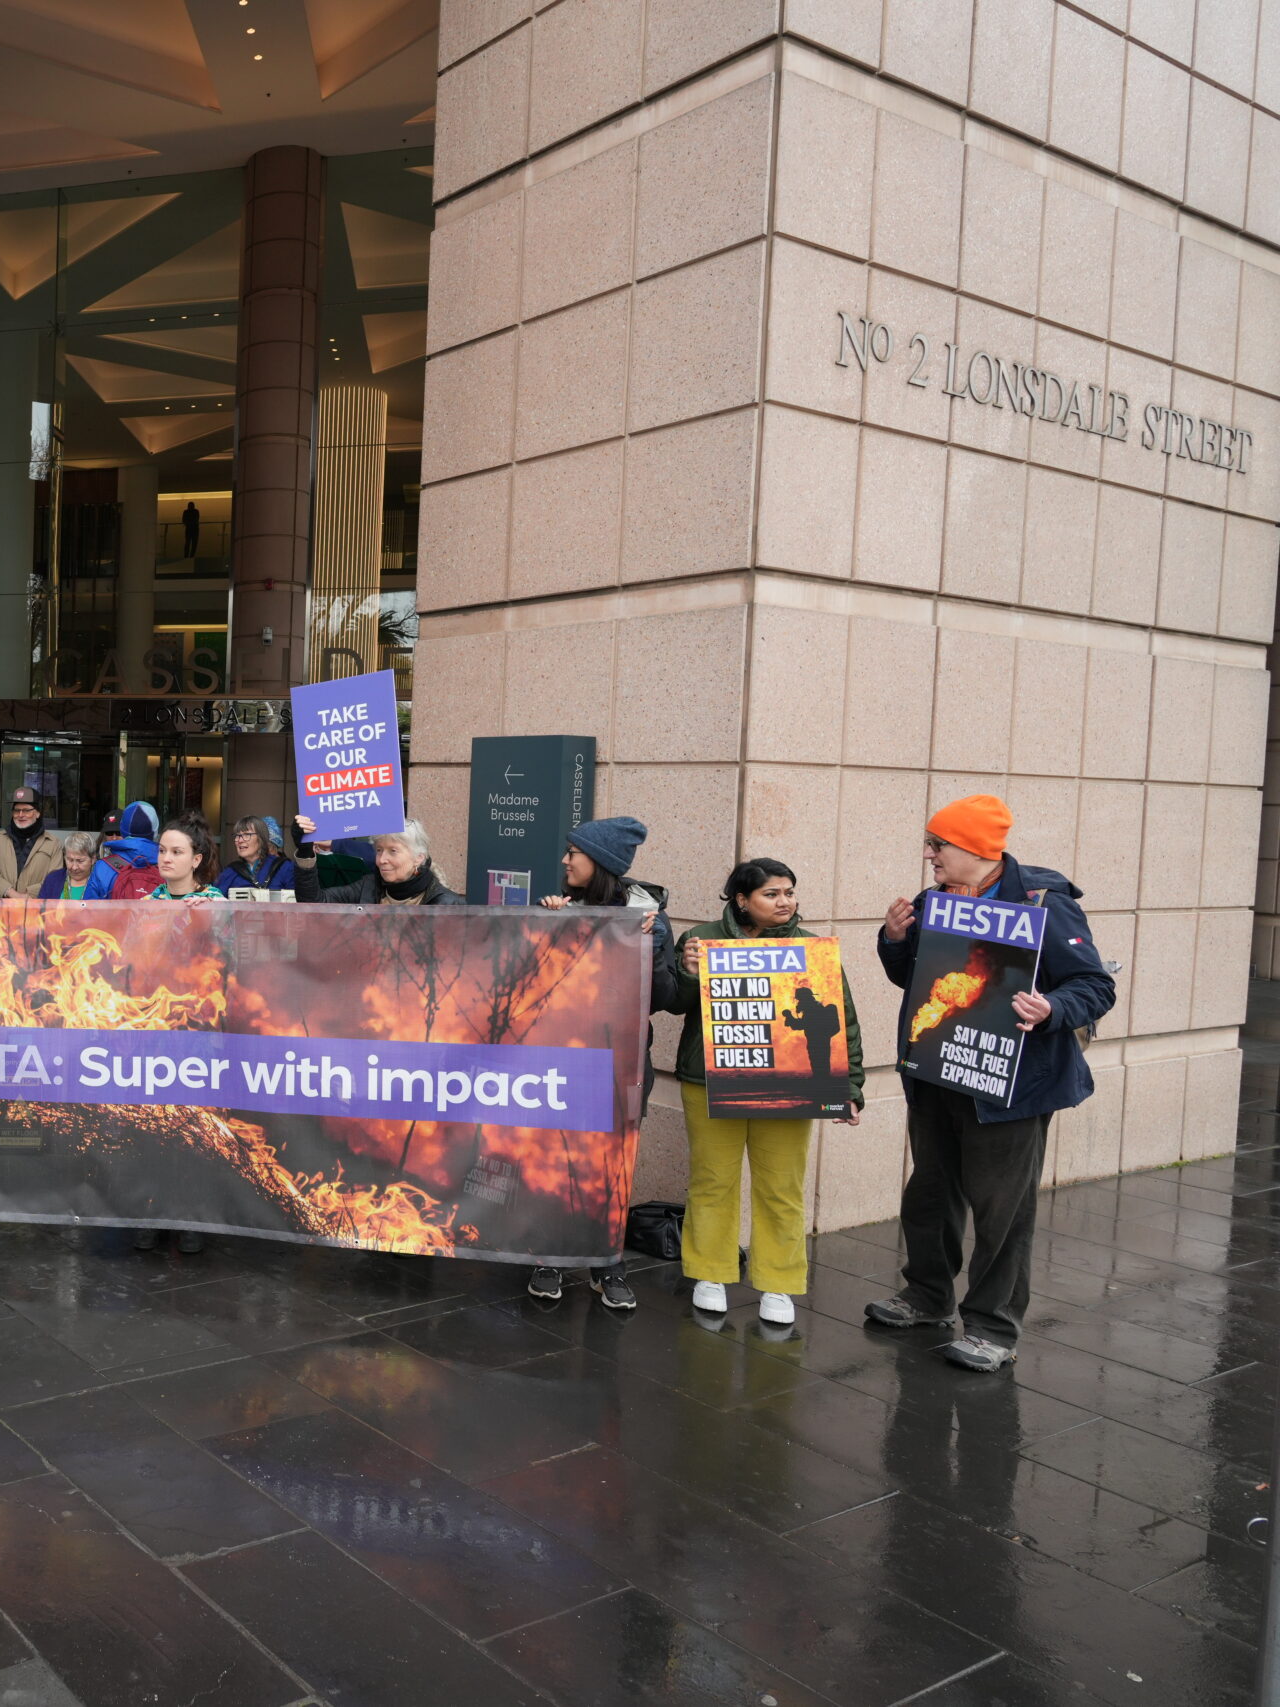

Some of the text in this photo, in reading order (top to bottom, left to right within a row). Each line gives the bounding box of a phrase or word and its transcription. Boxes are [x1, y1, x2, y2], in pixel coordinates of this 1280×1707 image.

[907, 333, 929, 388] 2
[942, 342, 1128, 442] LONSDALE
[1142, 403, 1252, 474] STREET
[121, 707, 132, 723] 2
[144, 707, 266, 725] LONSDALE
[317, 703, 368, 727] TAKE
[304, 722, 386, 750] CARE OF
[325, 748, 367, 768] OUR
[306, 766, 390, 792] CLIMATE
[488, 793, 539, 805] Madame
[572, 753, 584, 828] CASSELDEN
[319, 791, 380, 813] HESTA
[491, 809, 535, 821] Brussels
[498, 824, 525, 837] Lane
[928, 897, 1034, 944] HESTA
[710, 950, 802, 971] HESTA
[710, 978, 769, 997] SAY NO
[712, 1002, 773, 1020] TO NEW
[713, 1025, 769, 1044] FOSSIL
[954, 1025, 1015, 1057] SAY NO TO
[715, 1049, 768, 1067] FUELS!
[940, 1041, 1009, 1078] FOSSIL FUEL
[79, 1046, 229, 1095] Super
[241, 1050, 352, 1099] with
[367, 1054, 568, 1112] impact
[940, 1062, 1007, 1098] EXPANSION
